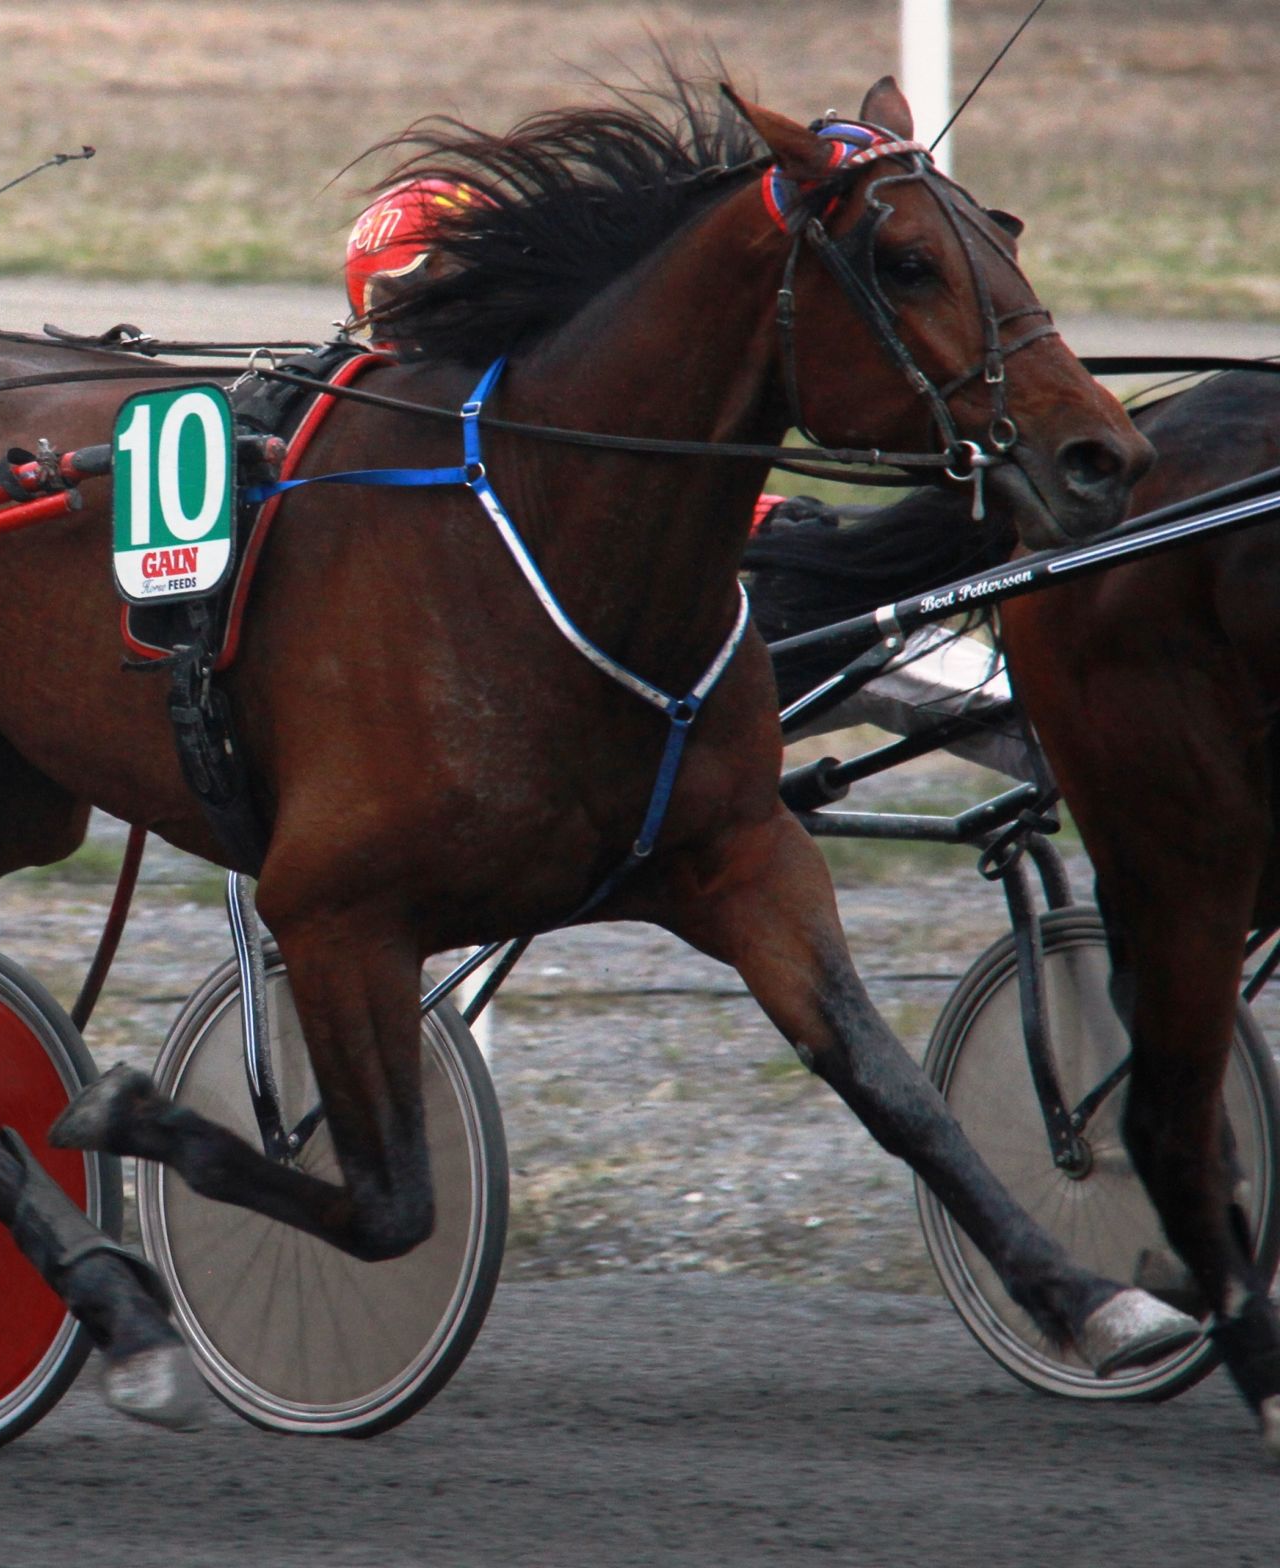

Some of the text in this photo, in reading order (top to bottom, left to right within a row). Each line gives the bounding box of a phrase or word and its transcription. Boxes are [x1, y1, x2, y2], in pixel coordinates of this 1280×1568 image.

[118, 392, 227, 546] 10
[141, 546, 199, 579] GAIN
[168, 577, 197, 591] FEEDS
[920, 570, 1033, 614] Bert Pettersson
